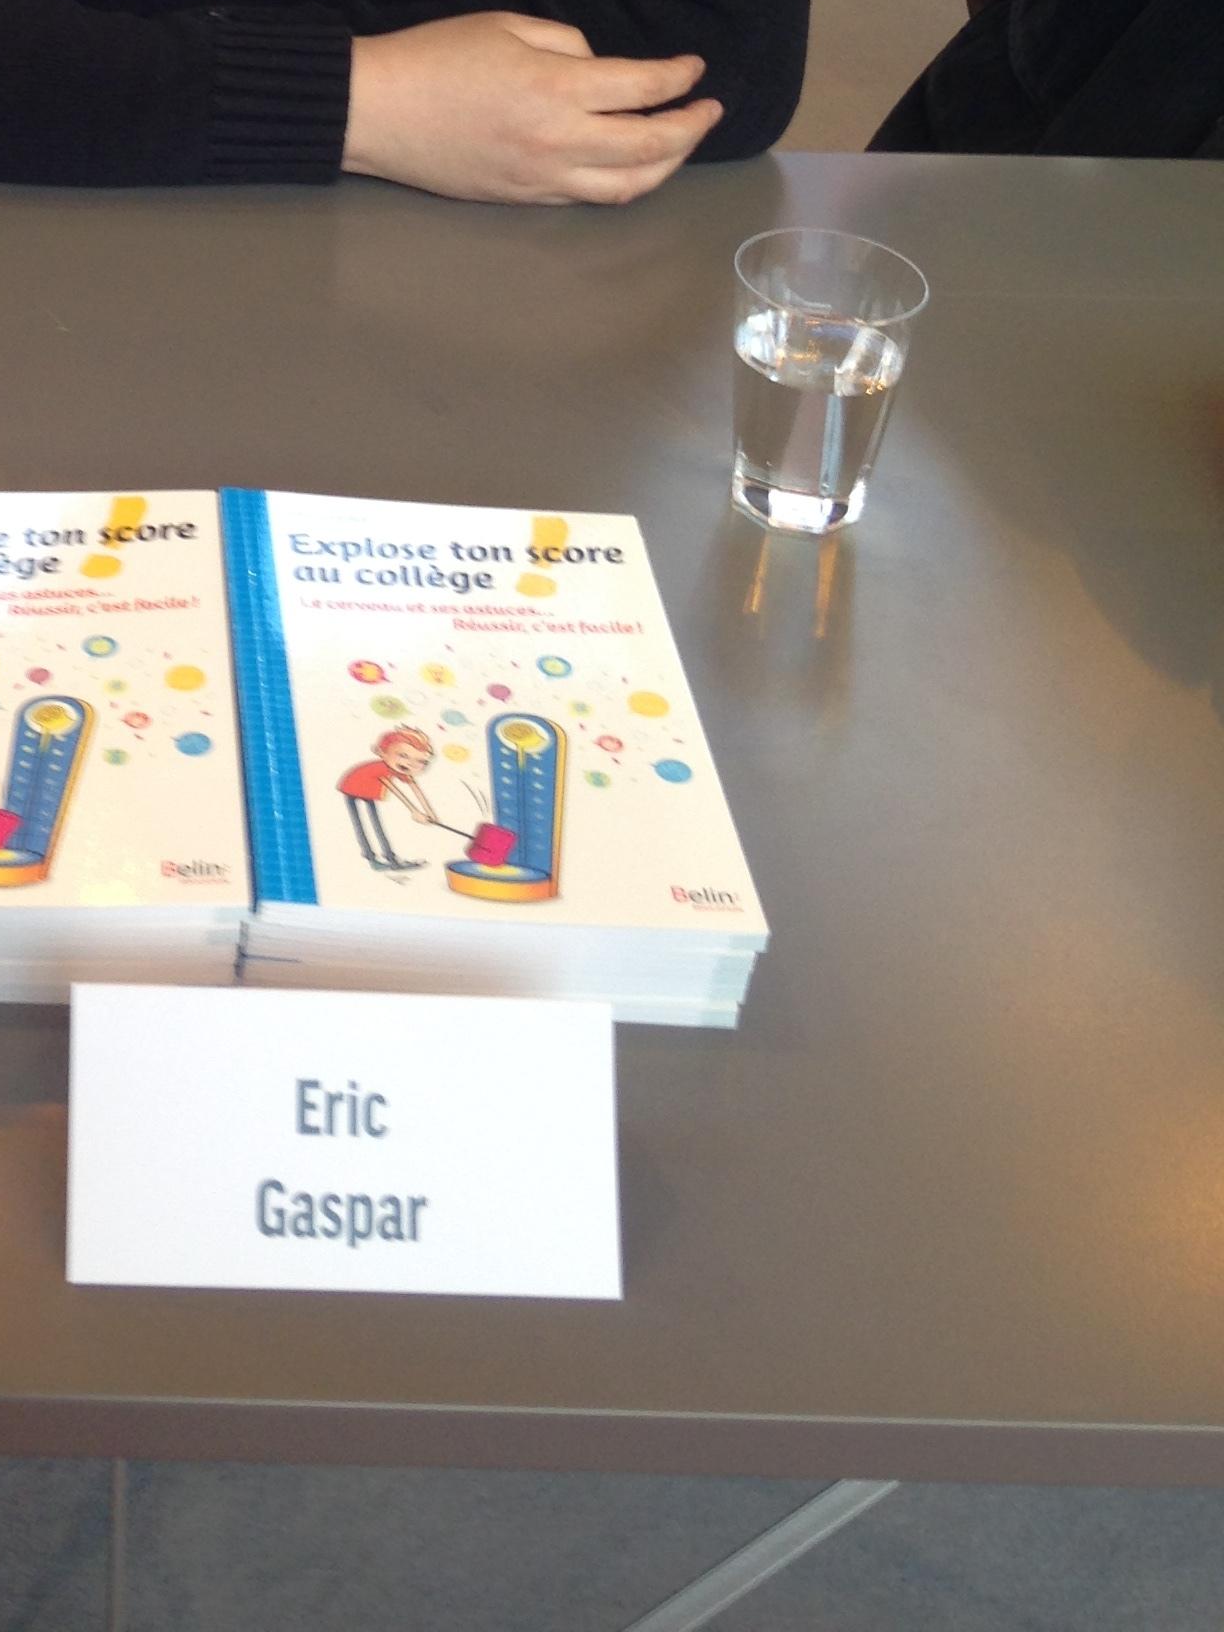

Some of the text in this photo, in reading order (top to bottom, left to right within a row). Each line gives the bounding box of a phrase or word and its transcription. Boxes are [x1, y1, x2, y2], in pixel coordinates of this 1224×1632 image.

[23, 526, 87, 548] ton
[97, 520, 199, 545] score
[288, 533, 626, 565] Explose ton score
[292, 564, 495, 595] au collège
[160, 859, 222, 878] Belin
[669, 884, 735, 905] Belin
[295, 1078, 389, 1138] Eric
[255, 1178, 429, 1248] Gaspar
